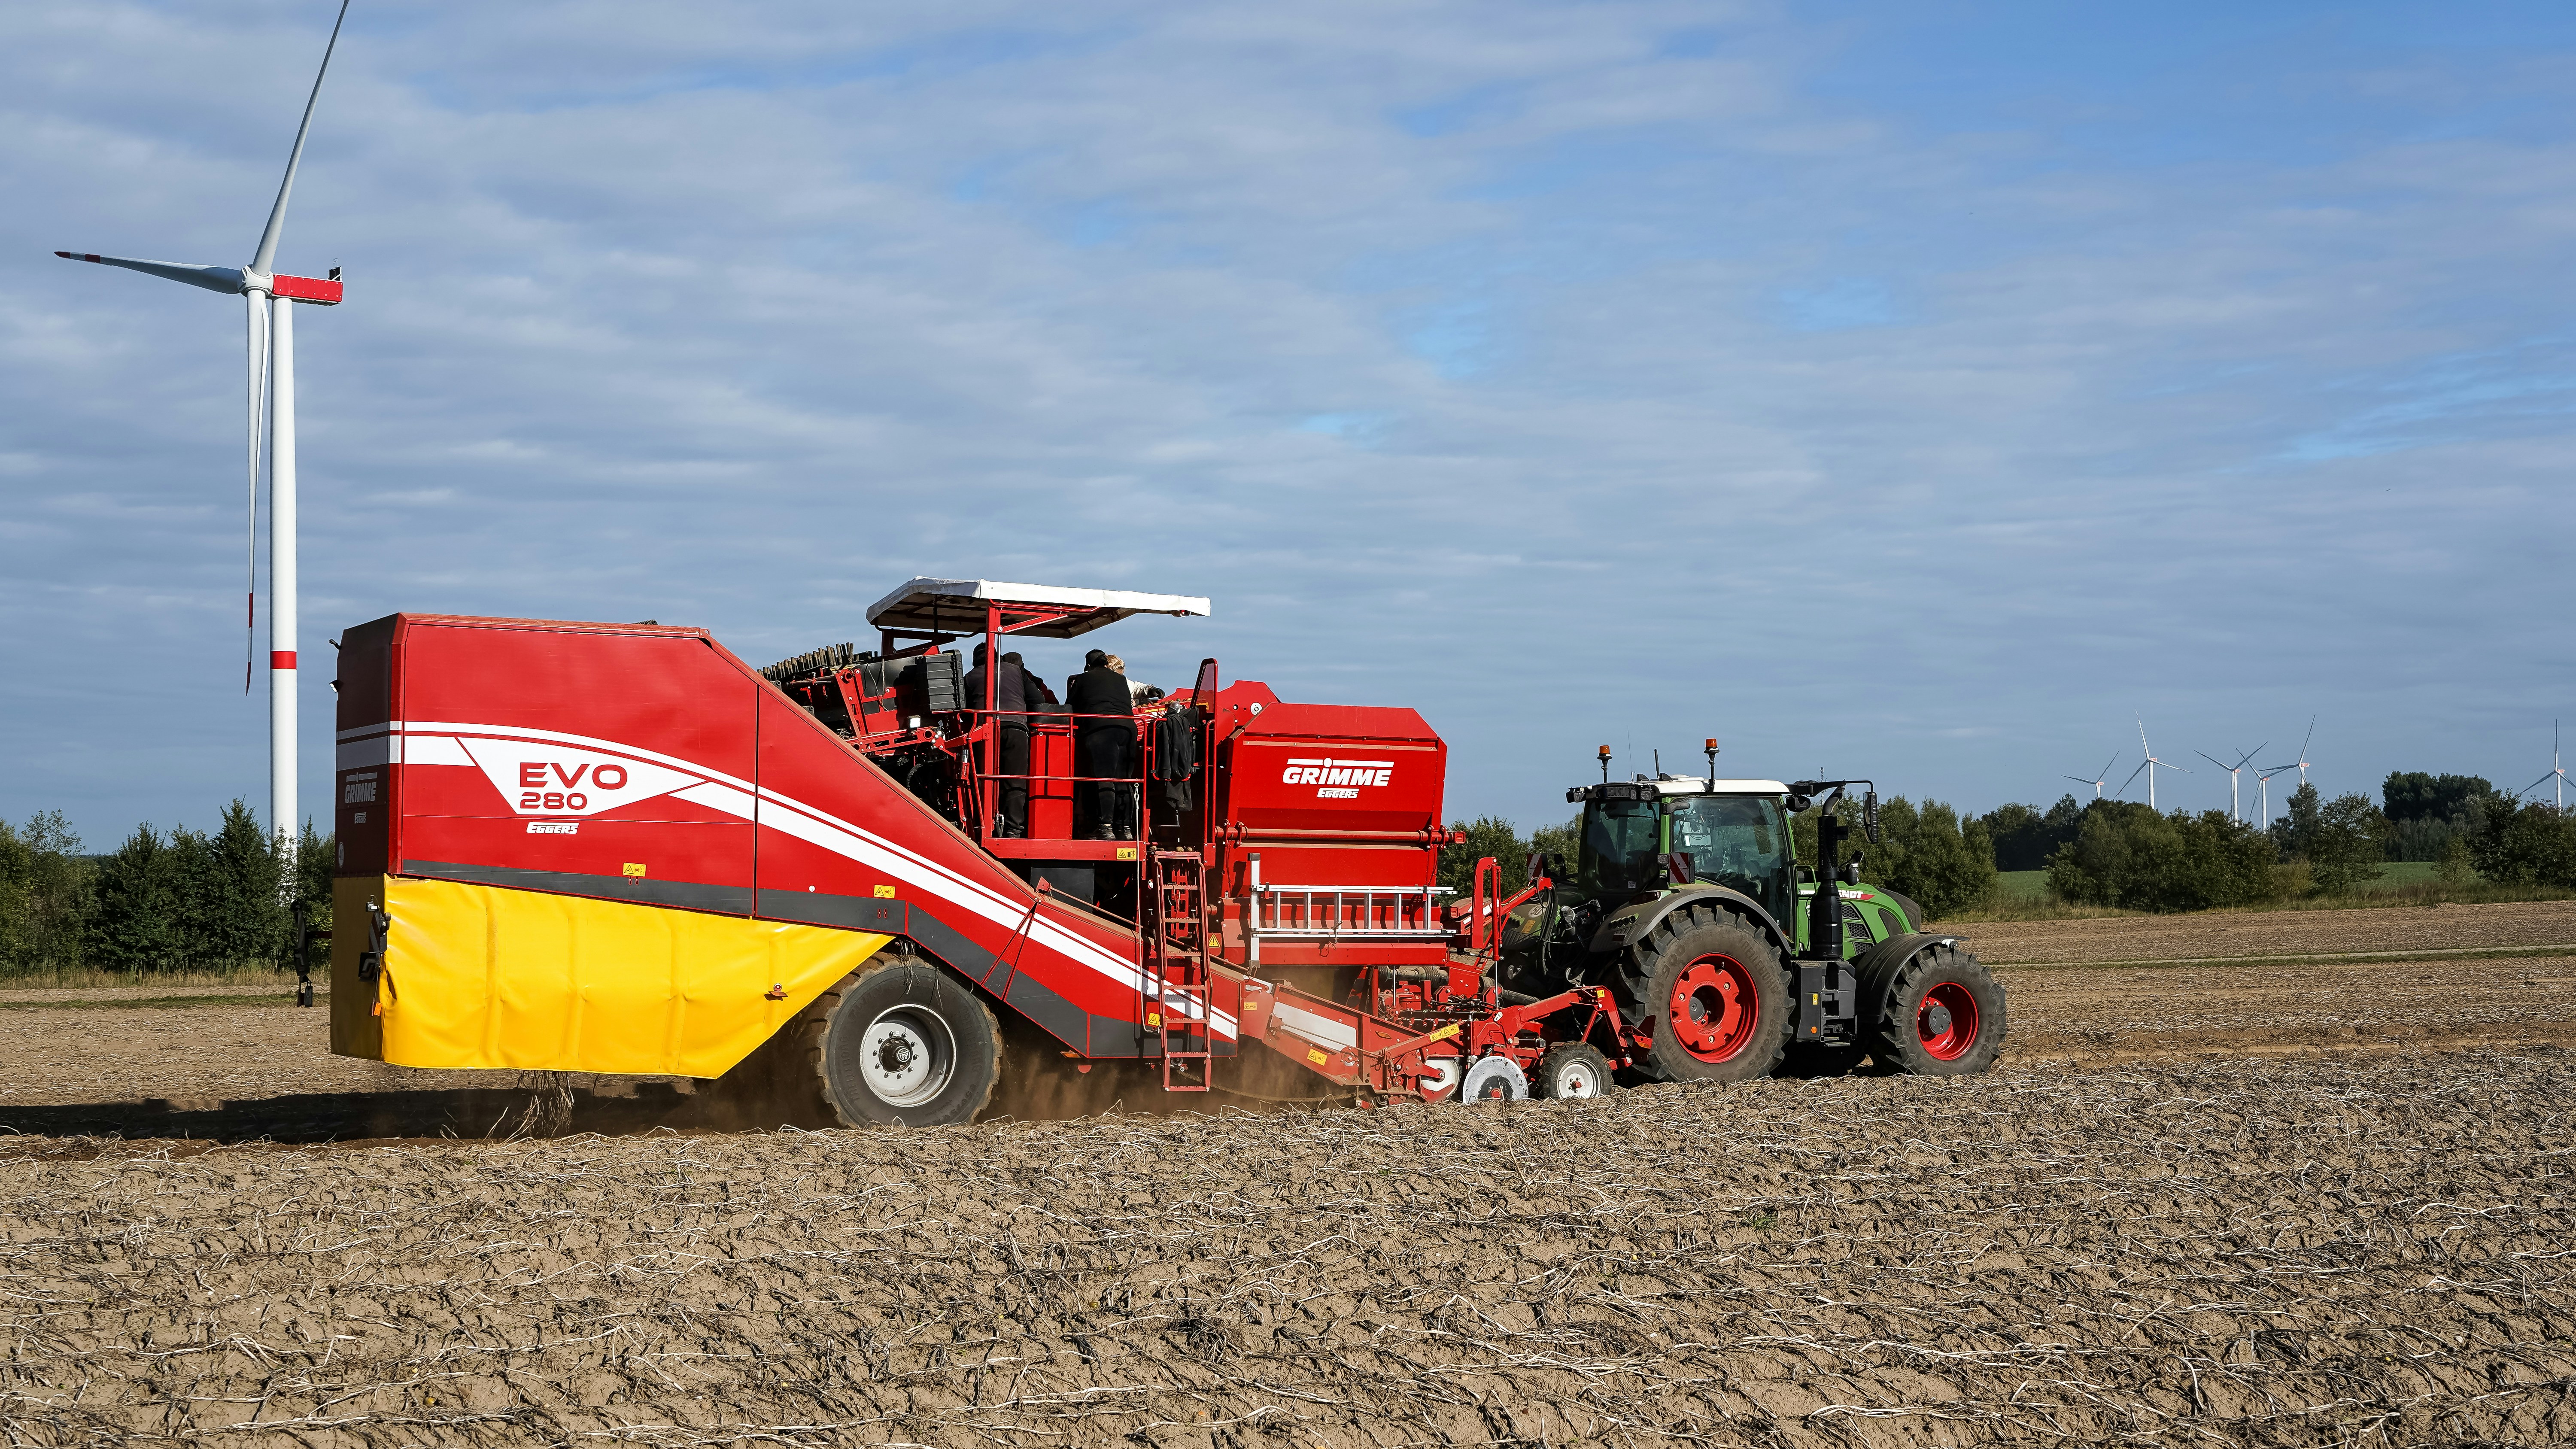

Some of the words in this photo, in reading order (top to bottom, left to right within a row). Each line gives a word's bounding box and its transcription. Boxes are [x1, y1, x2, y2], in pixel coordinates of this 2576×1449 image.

[520, 762, 627, 790] EVO
[1282, 757, 1393, 787] GRIMME
[345, 772, 377, 804] GRIMME
[1317, 788, 1359, 799] EGGERS
[520, 792, 587, 810] 280
[526, 822, 579, 834] EGGERS
[1838, 890, 1864, 899] ENDT
[1530, 906, 1542, 915] 50
